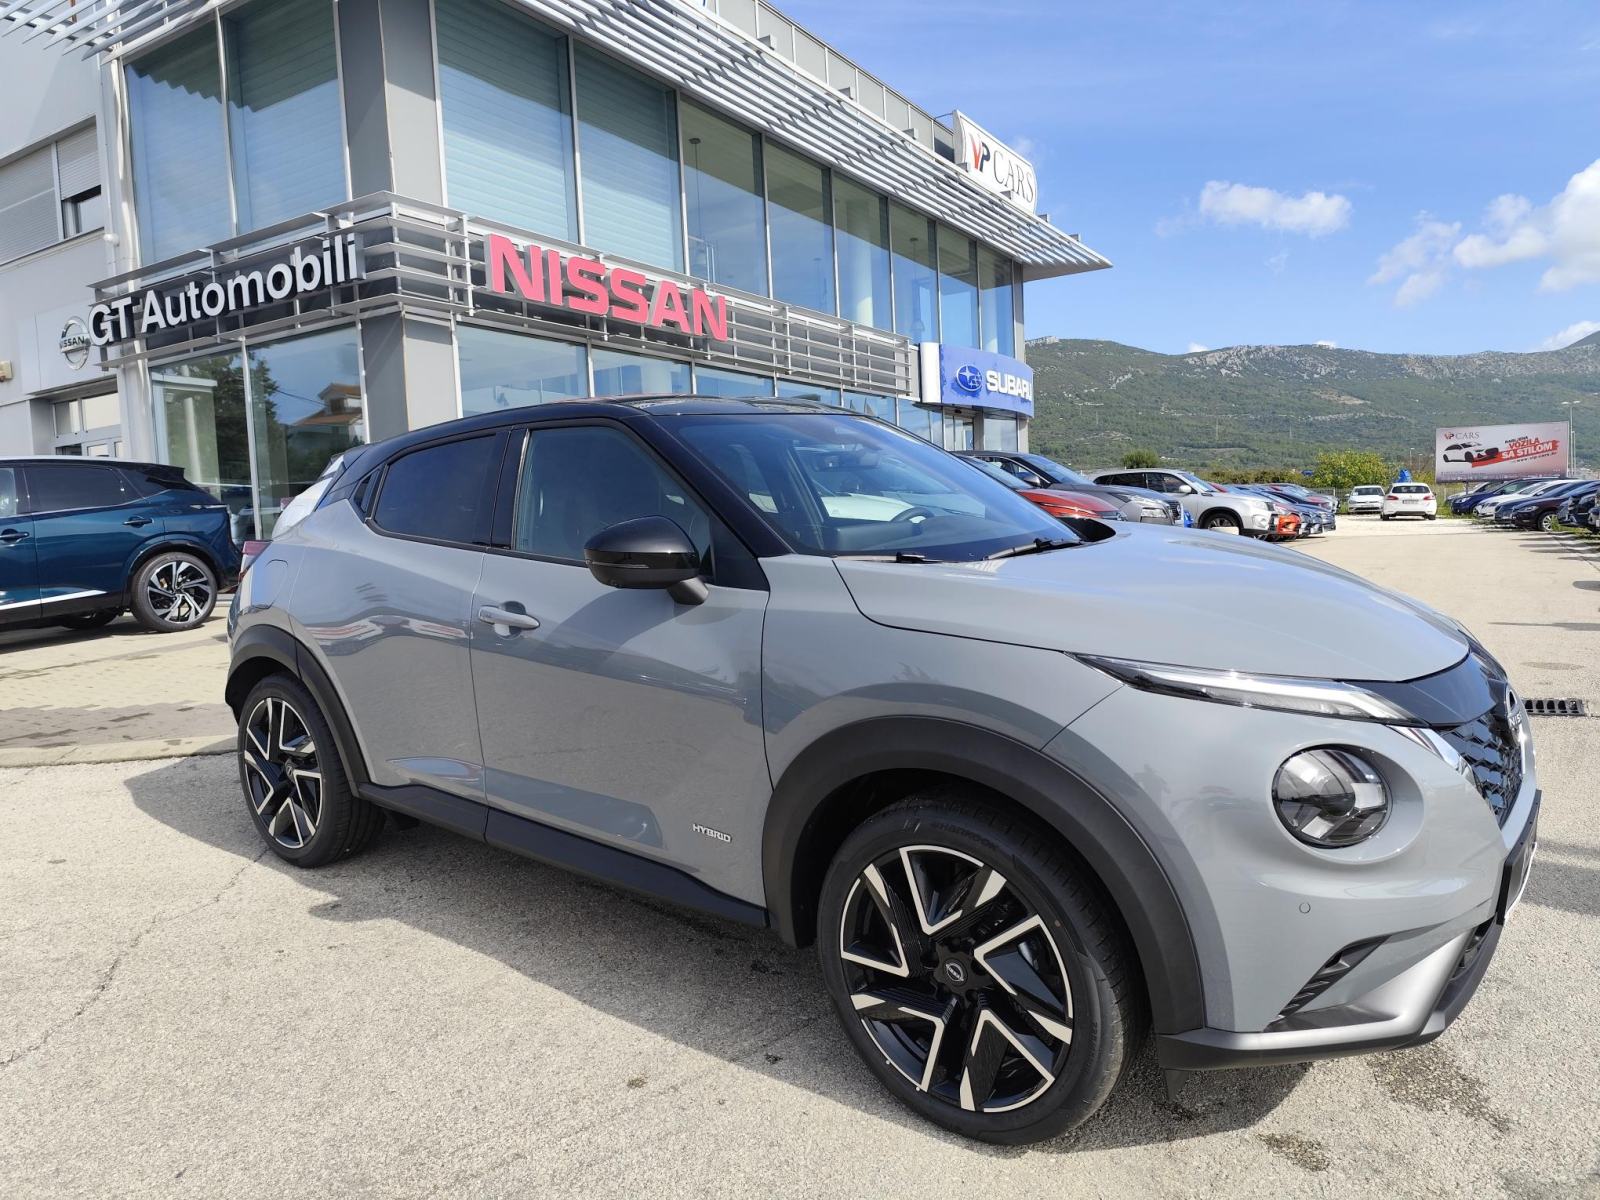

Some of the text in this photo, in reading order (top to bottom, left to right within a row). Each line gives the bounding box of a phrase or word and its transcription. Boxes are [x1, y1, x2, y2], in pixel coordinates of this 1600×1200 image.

[993, 150, 1034, 204] CARS
[88, 232, 358, 346] GT Automobili
[487, 233, 728, 342] NISSAN
[1456, 431, 1480, 440] CARS
[1508, 437, 1541, 449] VOZILA
[1501, 441, 1553, 460] SA STILOM
[692, 823, 731, 843] HYBRID
